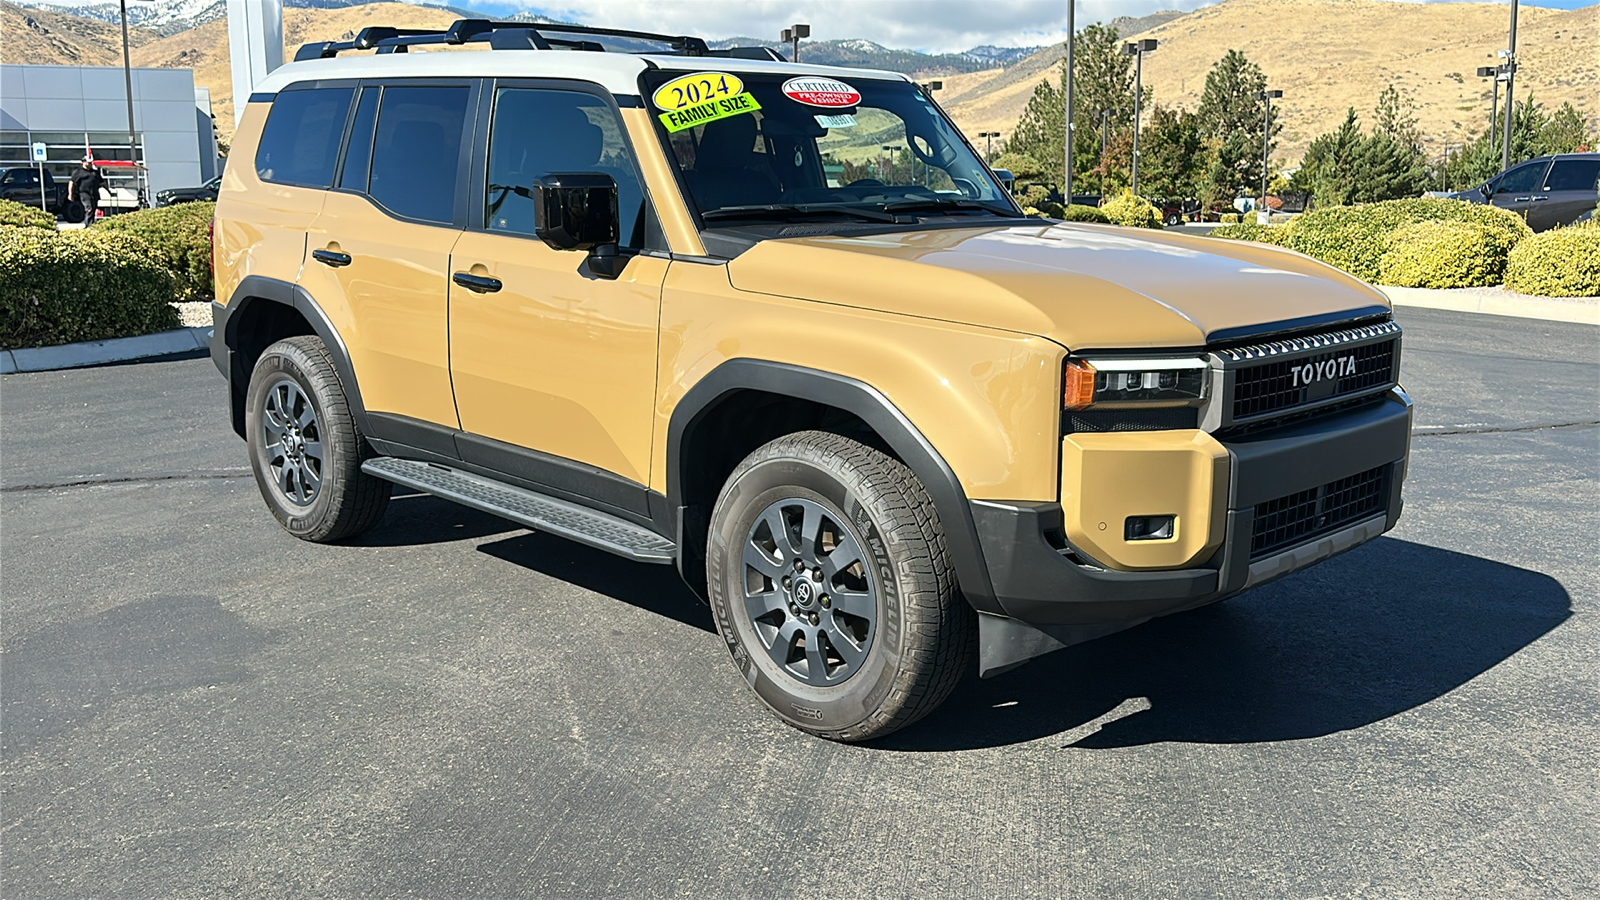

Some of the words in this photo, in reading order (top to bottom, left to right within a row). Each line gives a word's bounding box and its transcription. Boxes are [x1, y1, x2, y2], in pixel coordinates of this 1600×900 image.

[671, 75, 729, 108] 2024
[788, 82, 849, 92] CERTIFIED
[667, 102, 718, 127] FAMILY
[719, 95, 750, 113] SIZE
[1291, 355, 1356, 387] TOYOTA
[712, 549, 736, 644] MICHELIN
[869, 537, 898, 648] MICHELIN
